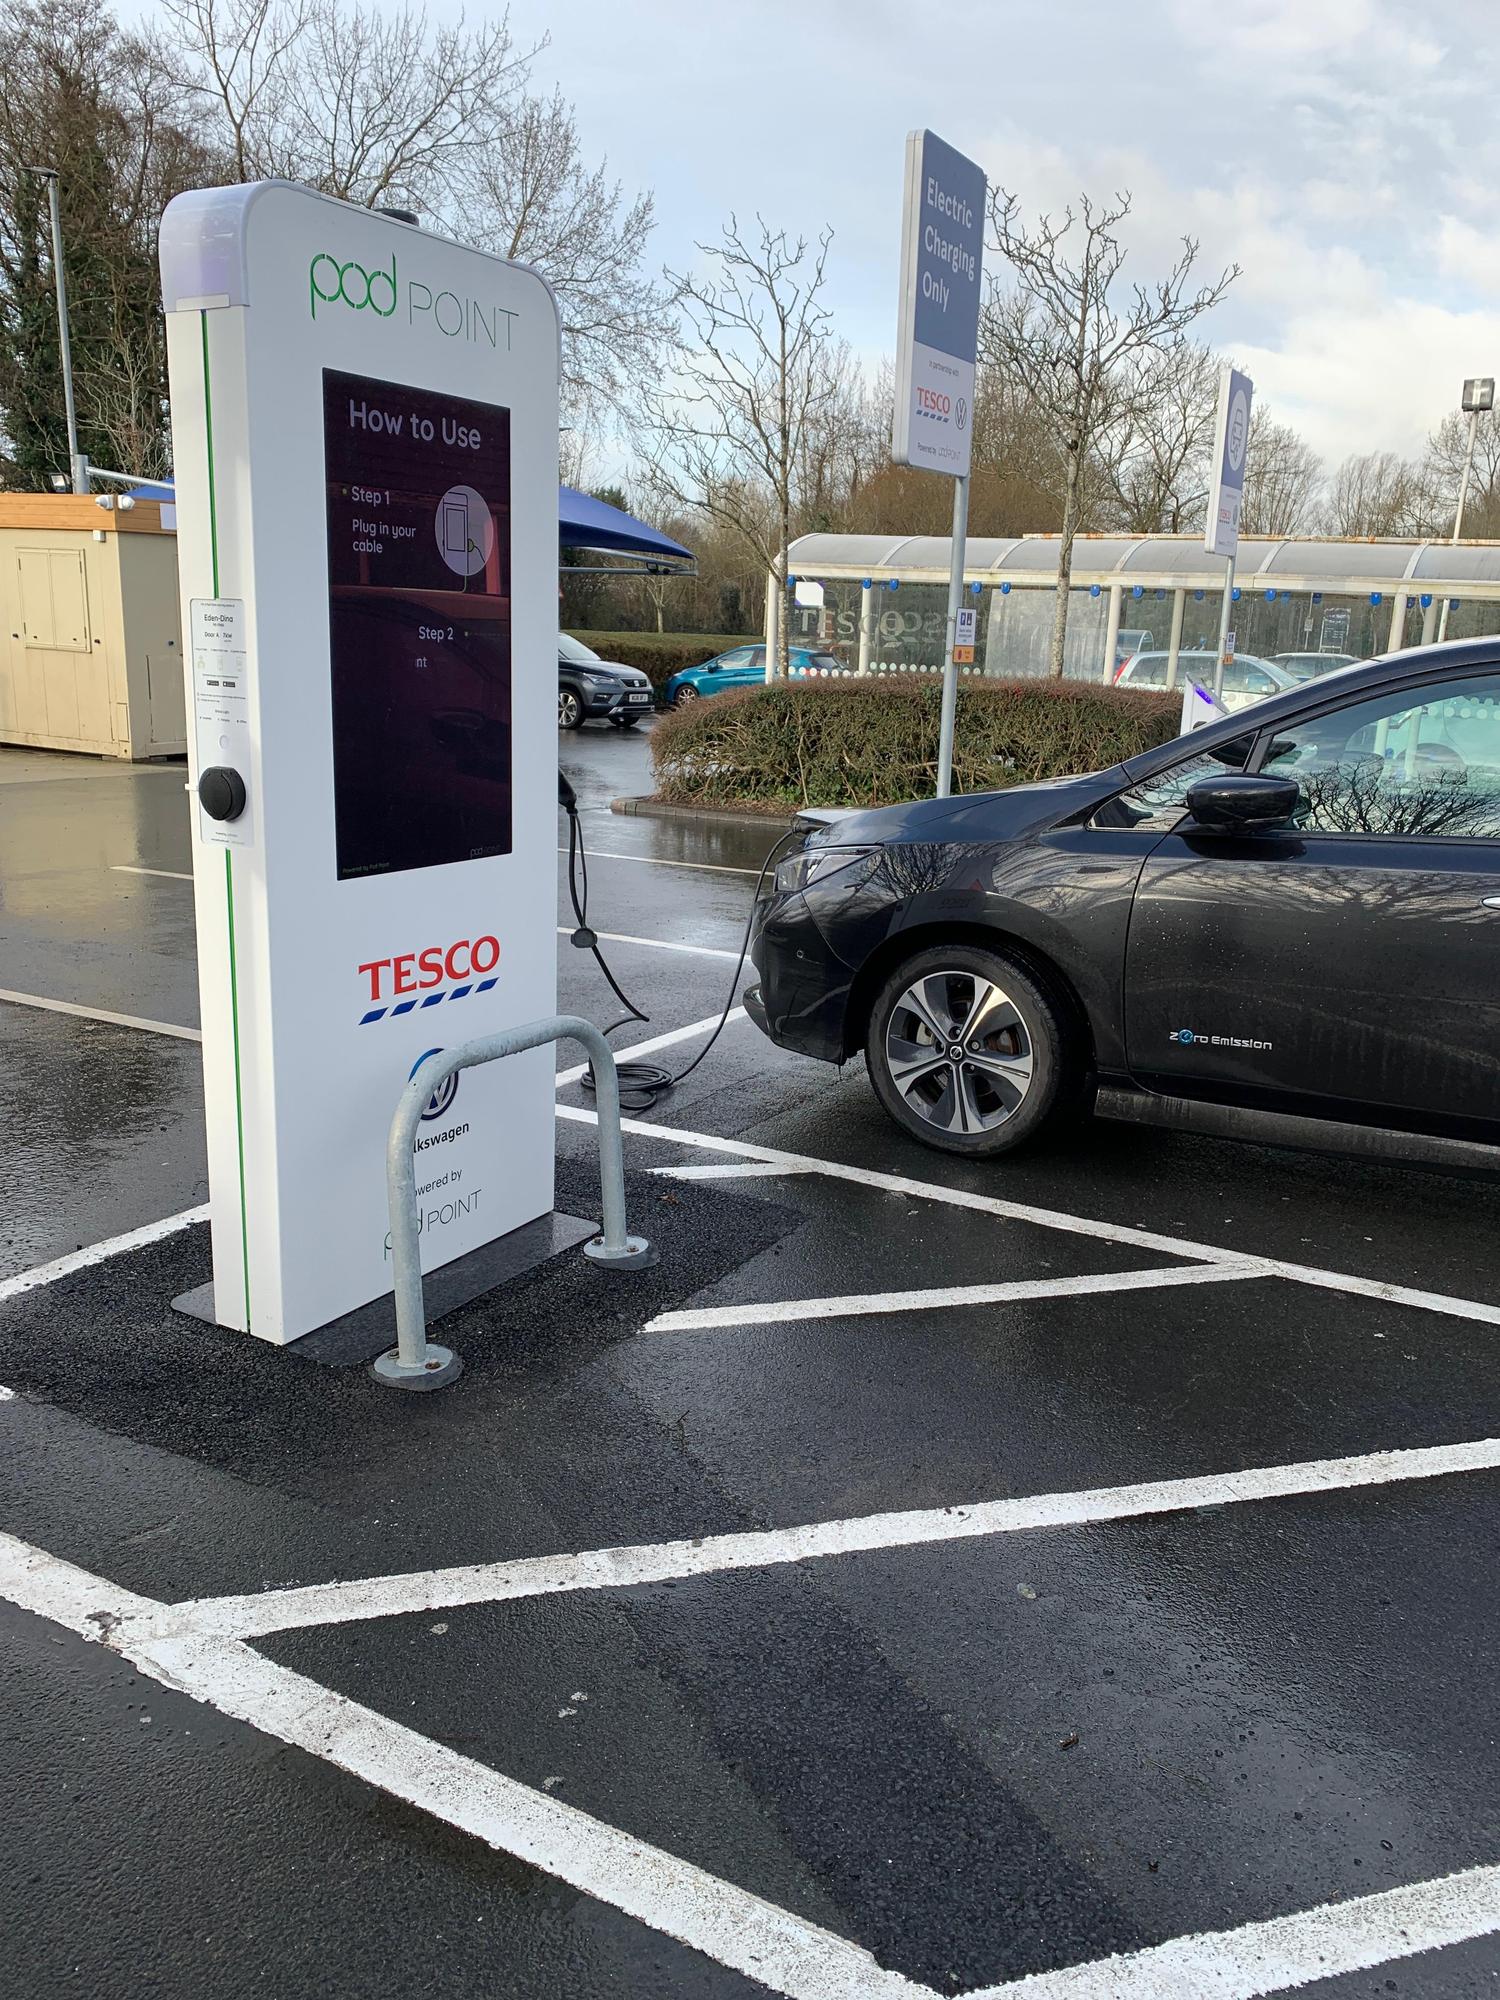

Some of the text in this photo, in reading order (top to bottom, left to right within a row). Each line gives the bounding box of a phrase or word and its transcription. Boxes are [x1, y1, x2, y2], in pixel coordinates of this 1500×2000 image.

[927, 176, 973, 230] Electric
[924, 224, 975, 282] Charging
[309, 252, 519, 352] pod POINT
[922, 270, 950, 313] Only
[917, 386, 951, 415] TESCO
[350, 398, 481, 450] How to Use
[351, 485, 390, 507] Step 1
[352, 518, 416, 540] Plug in your
[352, 539, 383, 554] cable
[418, 625, 454, 643] Step 2
[358, 935, 500, 1001] TESCO
[413, 1122, 469, 1154] lkswagen
[451, 1168, 462, 1183] by
[427, 1188, 482, 1233] POINT
